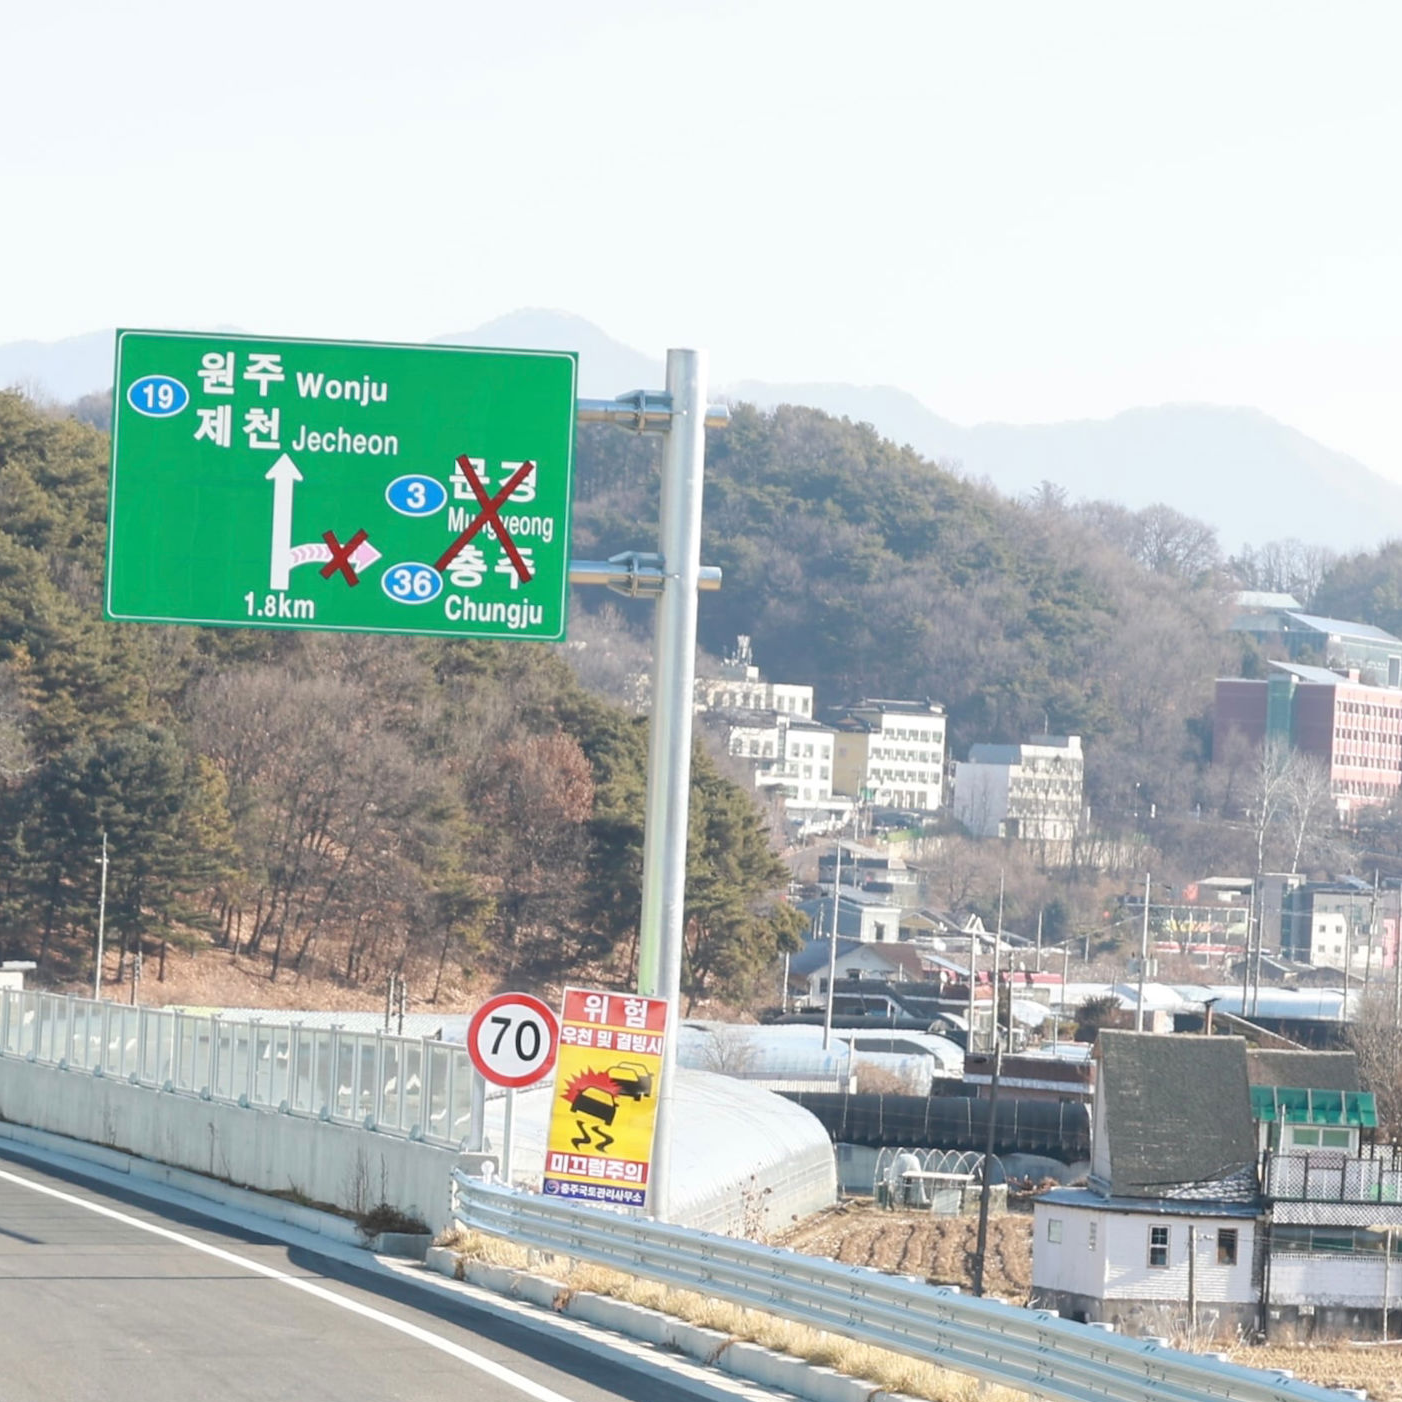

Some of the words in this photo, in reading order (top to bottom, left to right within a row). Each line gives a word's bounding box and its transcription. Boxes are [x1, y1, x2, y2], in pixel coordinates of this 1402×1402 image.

[197, 351, 285, 397] 원주
[296, 371, 389, 407] Wonju
[141, 383, 174, 410] 19
[194, 404, 282, 450] 제천
[292, 426, 398, 456] Jecheon
[406, 482, 427, 509] 3
[445, 544, 536, 590] 충주
[392, 570, 432, 598] 36
[243, 592, 315, 620] 1.8km
[444, 594, 543, 629] Chungju
[583, 995, 649, 1029] 위험
[491, 1016, 541, 1061] 70
[561, 1028, 593, 1046] 우천
[597, 1031, 612, 1048] 및
[617, 1034, 664, 1056] 결빙시
[550, 1154, 644, 1182] 미끄럼주의
[560, 1183, 643, 1203] 충주국토관리사무소
